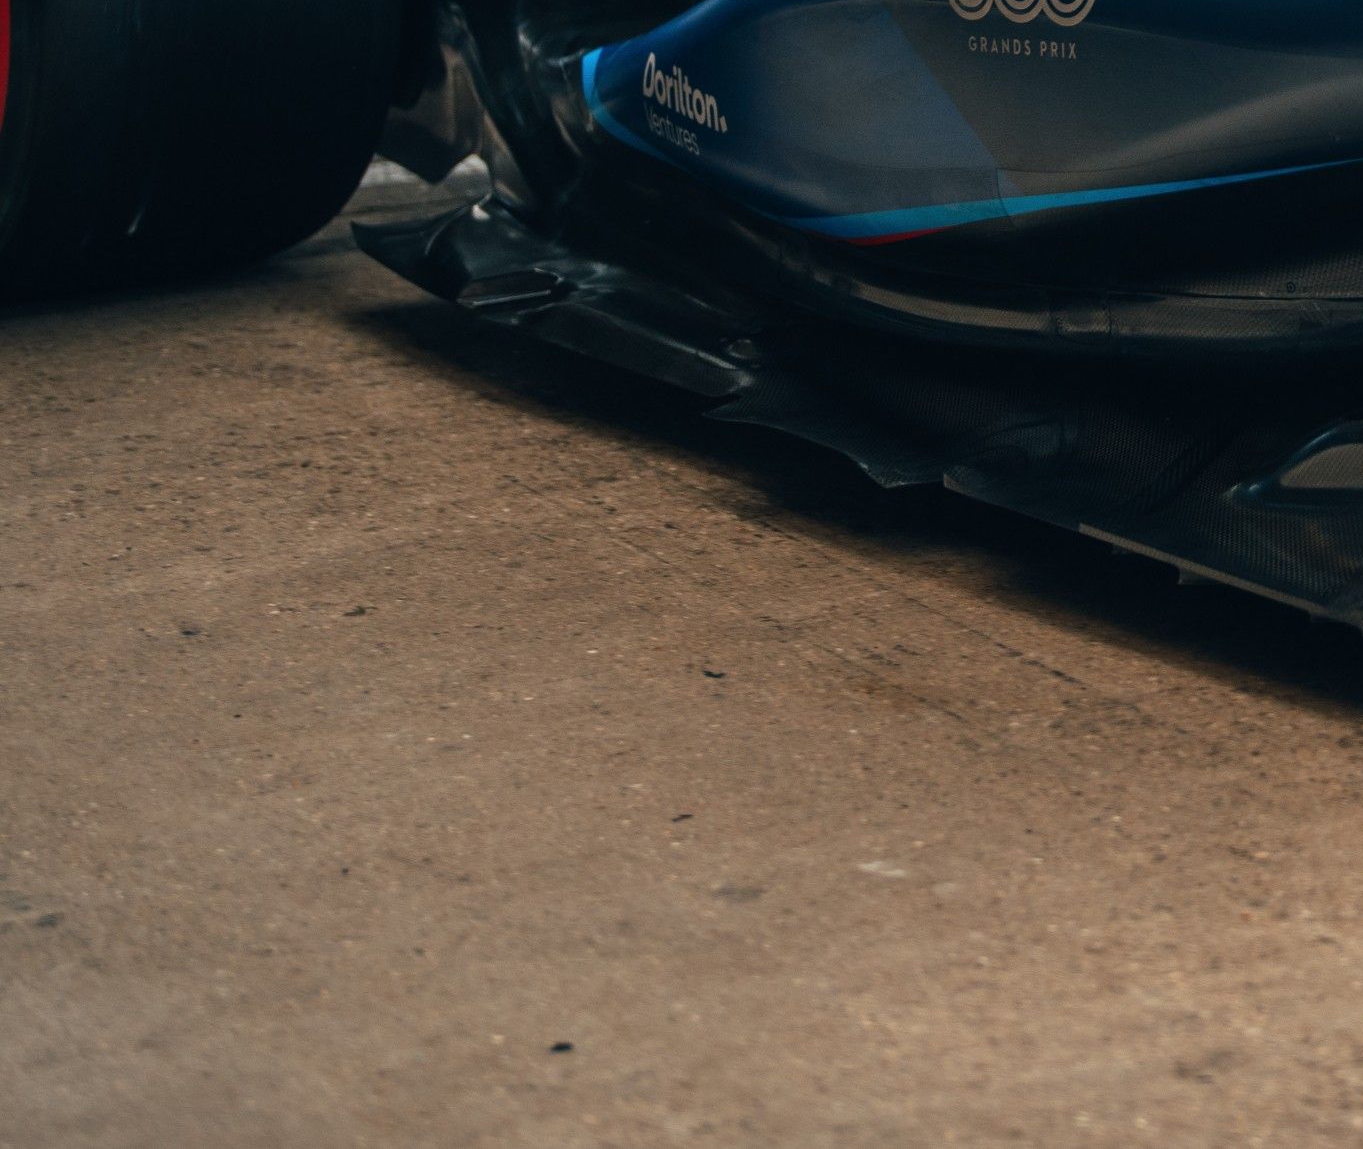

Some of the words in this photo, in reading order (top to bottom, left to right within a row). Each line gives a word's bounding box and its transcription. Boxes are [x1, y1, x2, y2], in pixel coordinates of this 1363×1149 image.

[968, 35, 1031, 56] GRANDS
[1039, 40, 1077, 59] PRIX
[643, 100, 700, 156] Ventures
